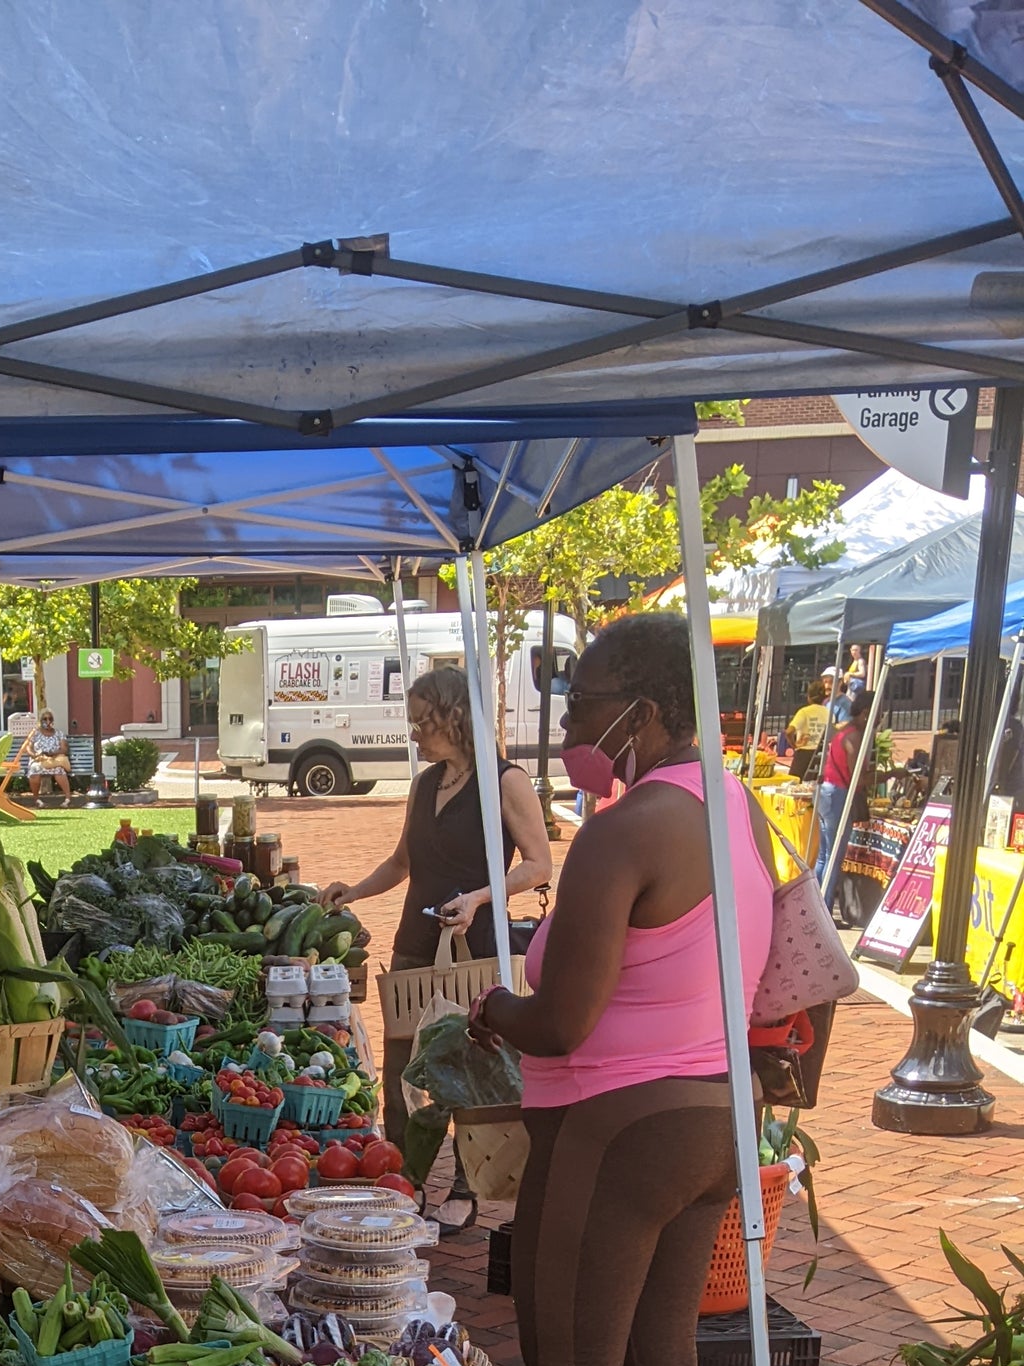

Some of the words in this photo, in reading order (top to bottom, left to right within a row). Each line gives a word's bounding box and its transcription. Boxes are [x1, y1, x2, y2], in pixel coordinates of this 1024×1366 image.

[860, 407, 919, 432] Garage
[280, 662, 321, 680] FLASH
[279, 679, 311, 688] CRABCAKE
